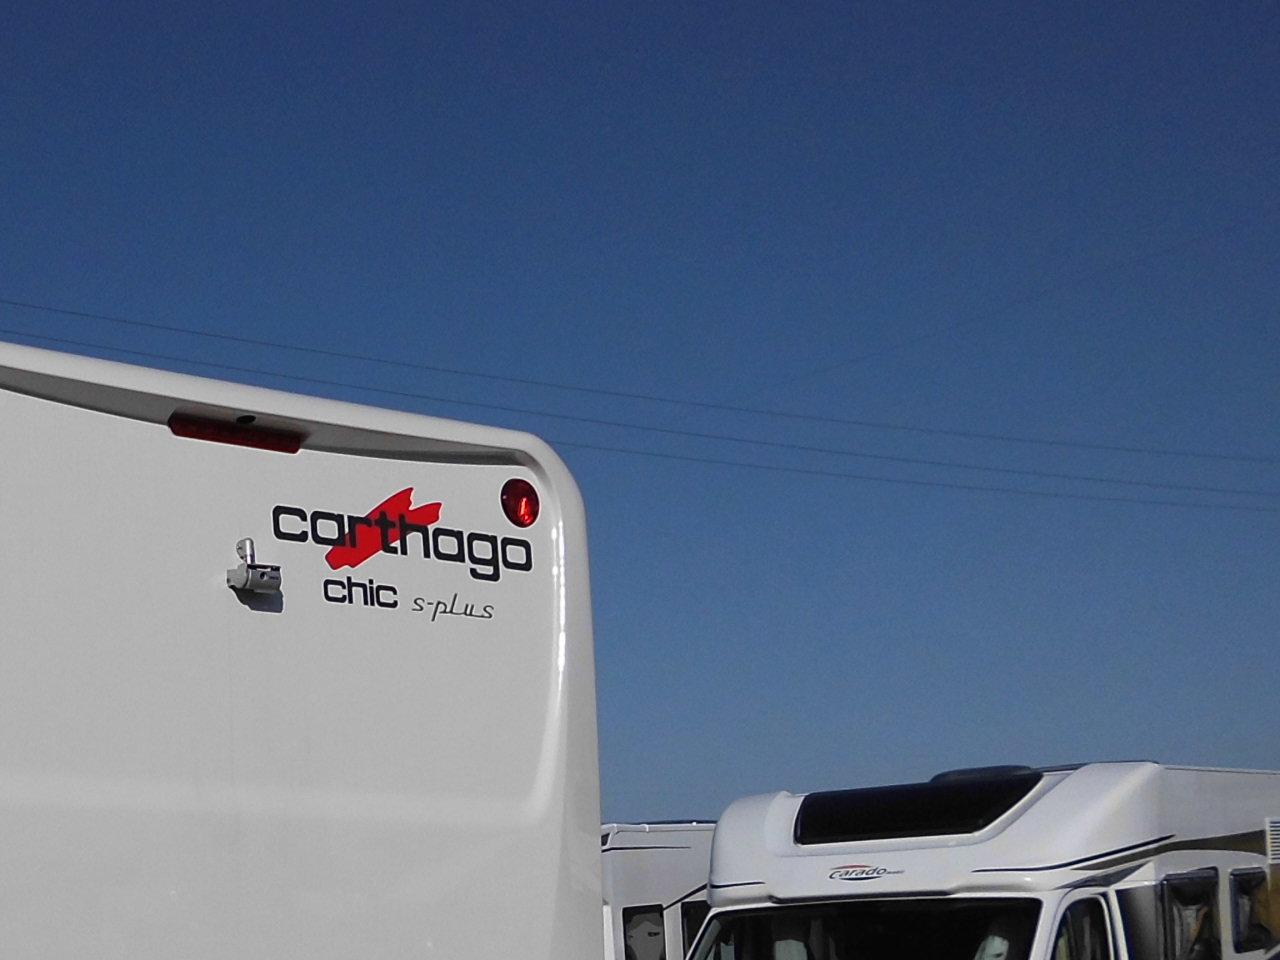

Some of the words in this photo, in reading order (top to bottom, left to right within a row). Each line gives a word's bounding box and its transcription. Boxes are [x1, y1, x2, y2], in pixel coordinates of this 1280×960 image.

[272, 505, 533, 582] carthago
[323, 576, 399, 609] chic
[412, 593, 495, 622] s-plus
